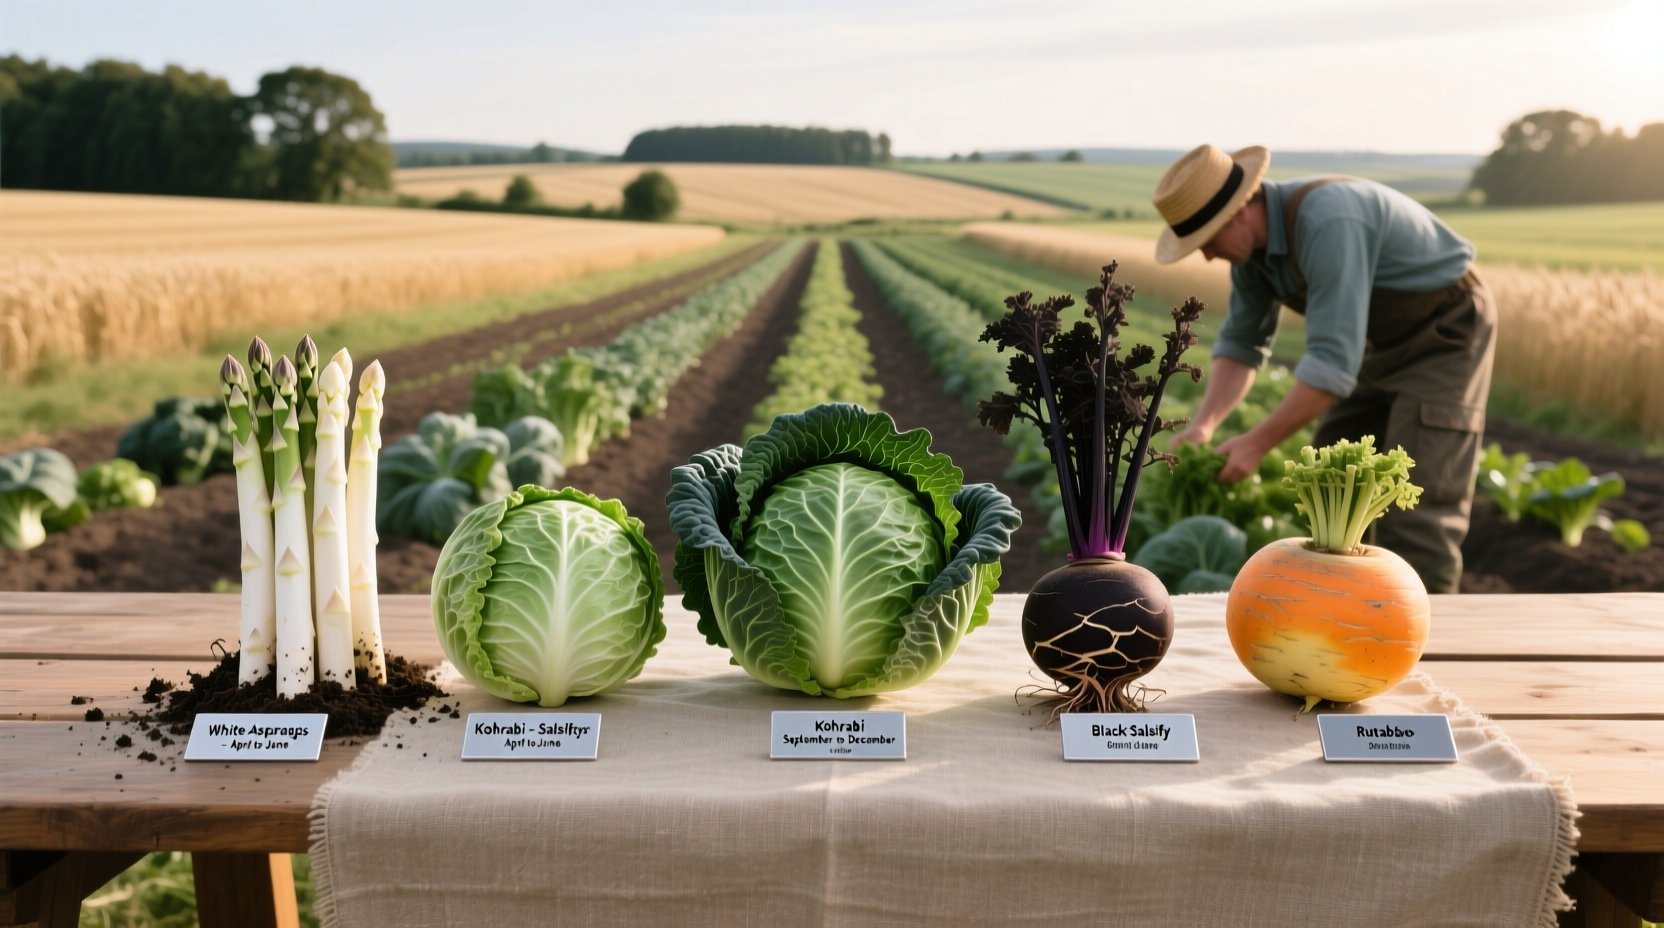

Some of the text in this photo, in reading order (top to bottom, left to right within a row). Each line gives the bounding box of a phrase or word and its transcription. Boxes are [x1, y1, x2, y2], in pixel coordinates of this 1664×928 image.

[209, 723, 246, 737] White
[475, 722, 526, 735] Kohrabi
[815, 719, 865, 732] Kohrabi
[1092, 723, 1171, 741] Black Salsify
[527, 739, 536, 748] to
